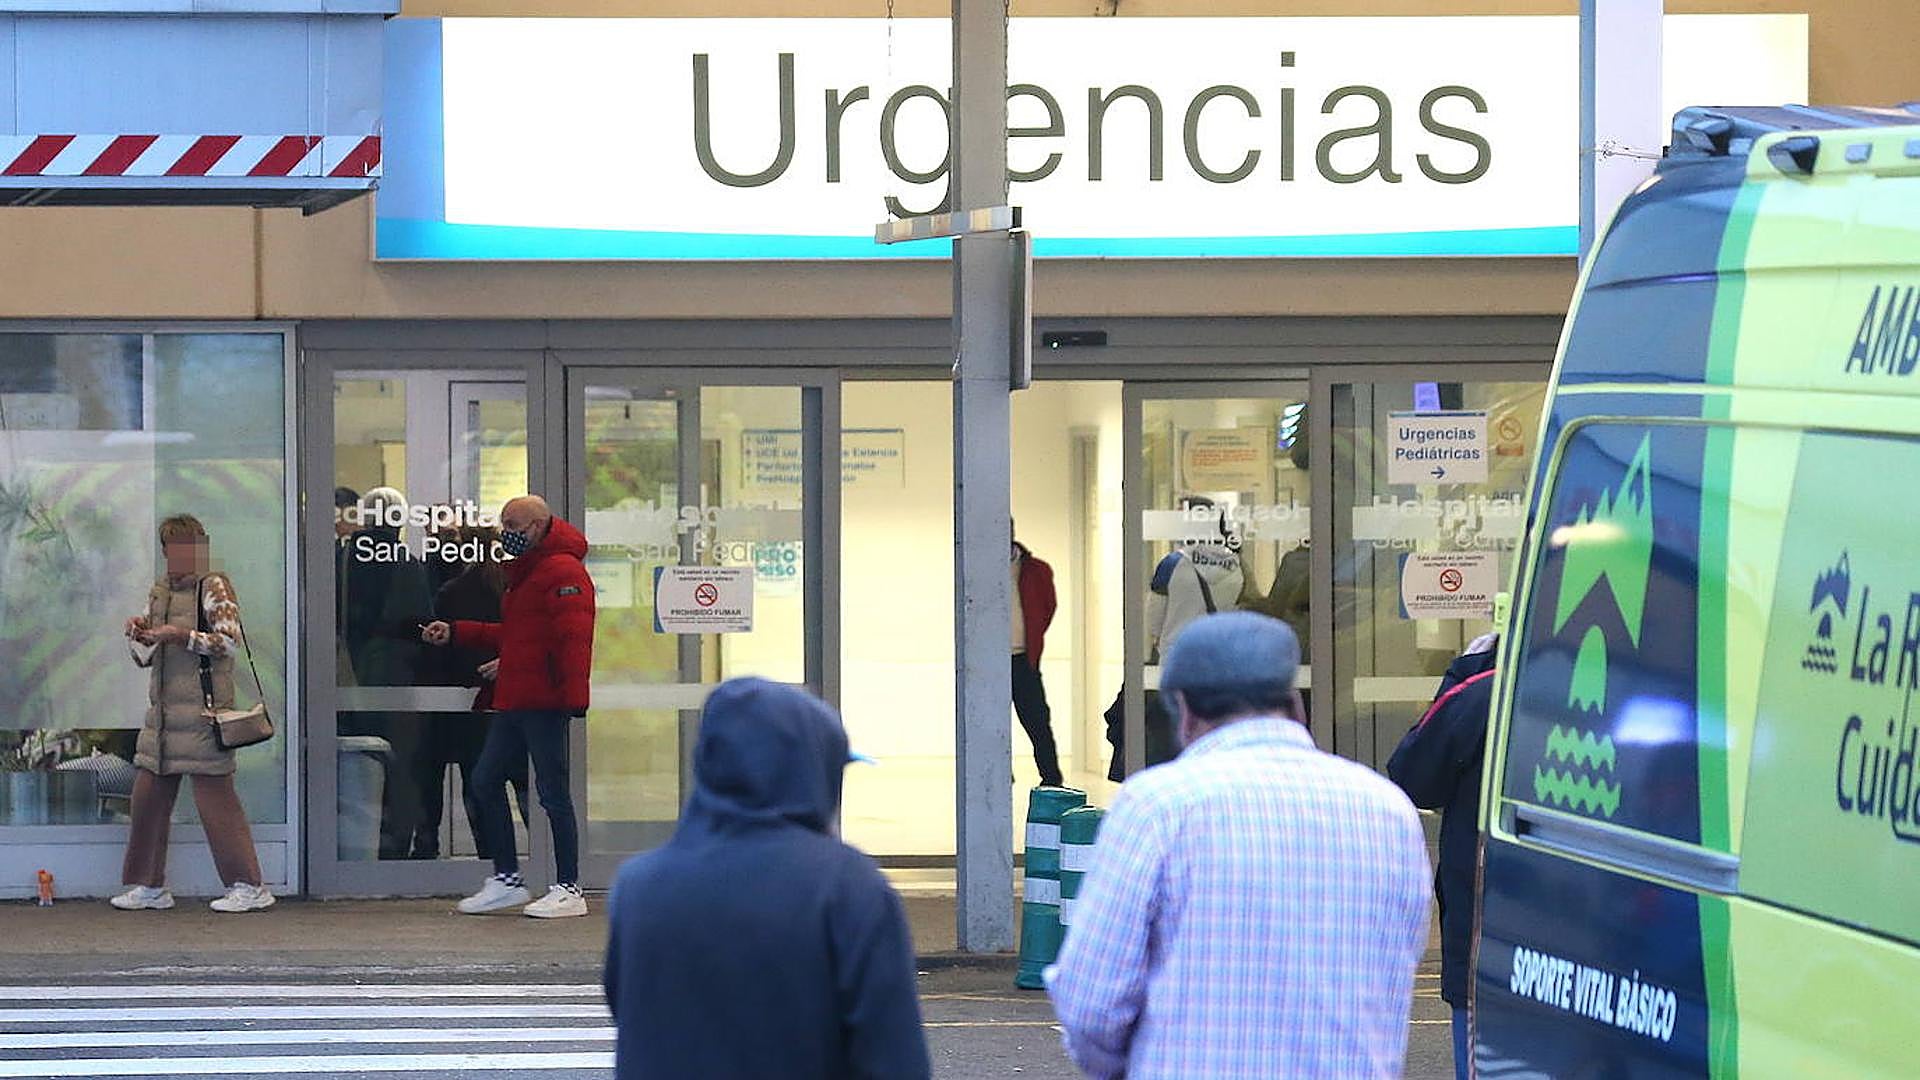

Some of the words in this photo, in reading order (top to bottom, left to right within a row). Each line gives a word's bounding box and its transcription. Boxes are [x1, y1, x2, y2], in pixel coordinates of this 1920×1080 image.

[691, 50, 1493, 219] Urgencias
[1399, 427, 1476, 444] Urgencias
[1395, 445, 1480, 461] Pediátricas
[356, 499, 504, 533] Hospita
[355, 535, 411, 563] San
[1459, 594, 1486, 602] FUMAR
[1850, 585, 1891, 685] La
[1510, 945, 1575, 1011] SOPORTE
[1574, 964, 1614, 1025] VITAL
[1615, 968, 1678, 1043] BÁSICO
